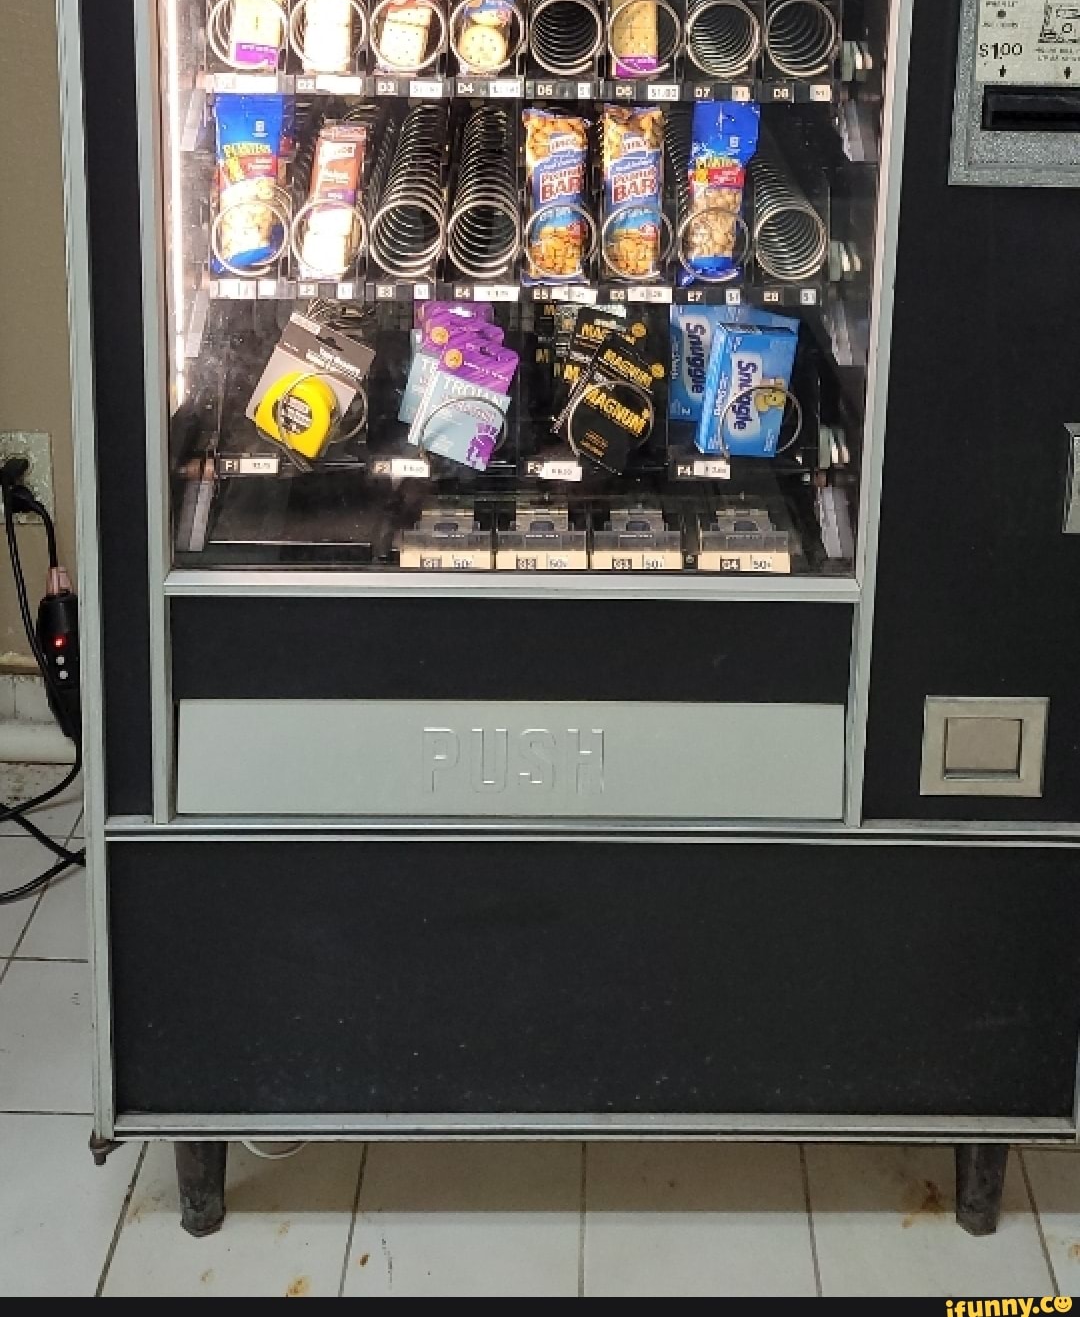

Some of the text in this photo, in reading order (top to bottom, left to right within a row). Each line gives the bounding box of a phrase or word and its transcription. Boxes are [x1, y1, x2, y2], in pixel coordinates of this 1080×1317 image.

[457, 82, 475, 95] D4
[540, 176, 583, 203] BAR
[612, 178, 657, 203] BAR
[224, 460, 239, 472] F1
[422, 726, 605, 794] PUSH
